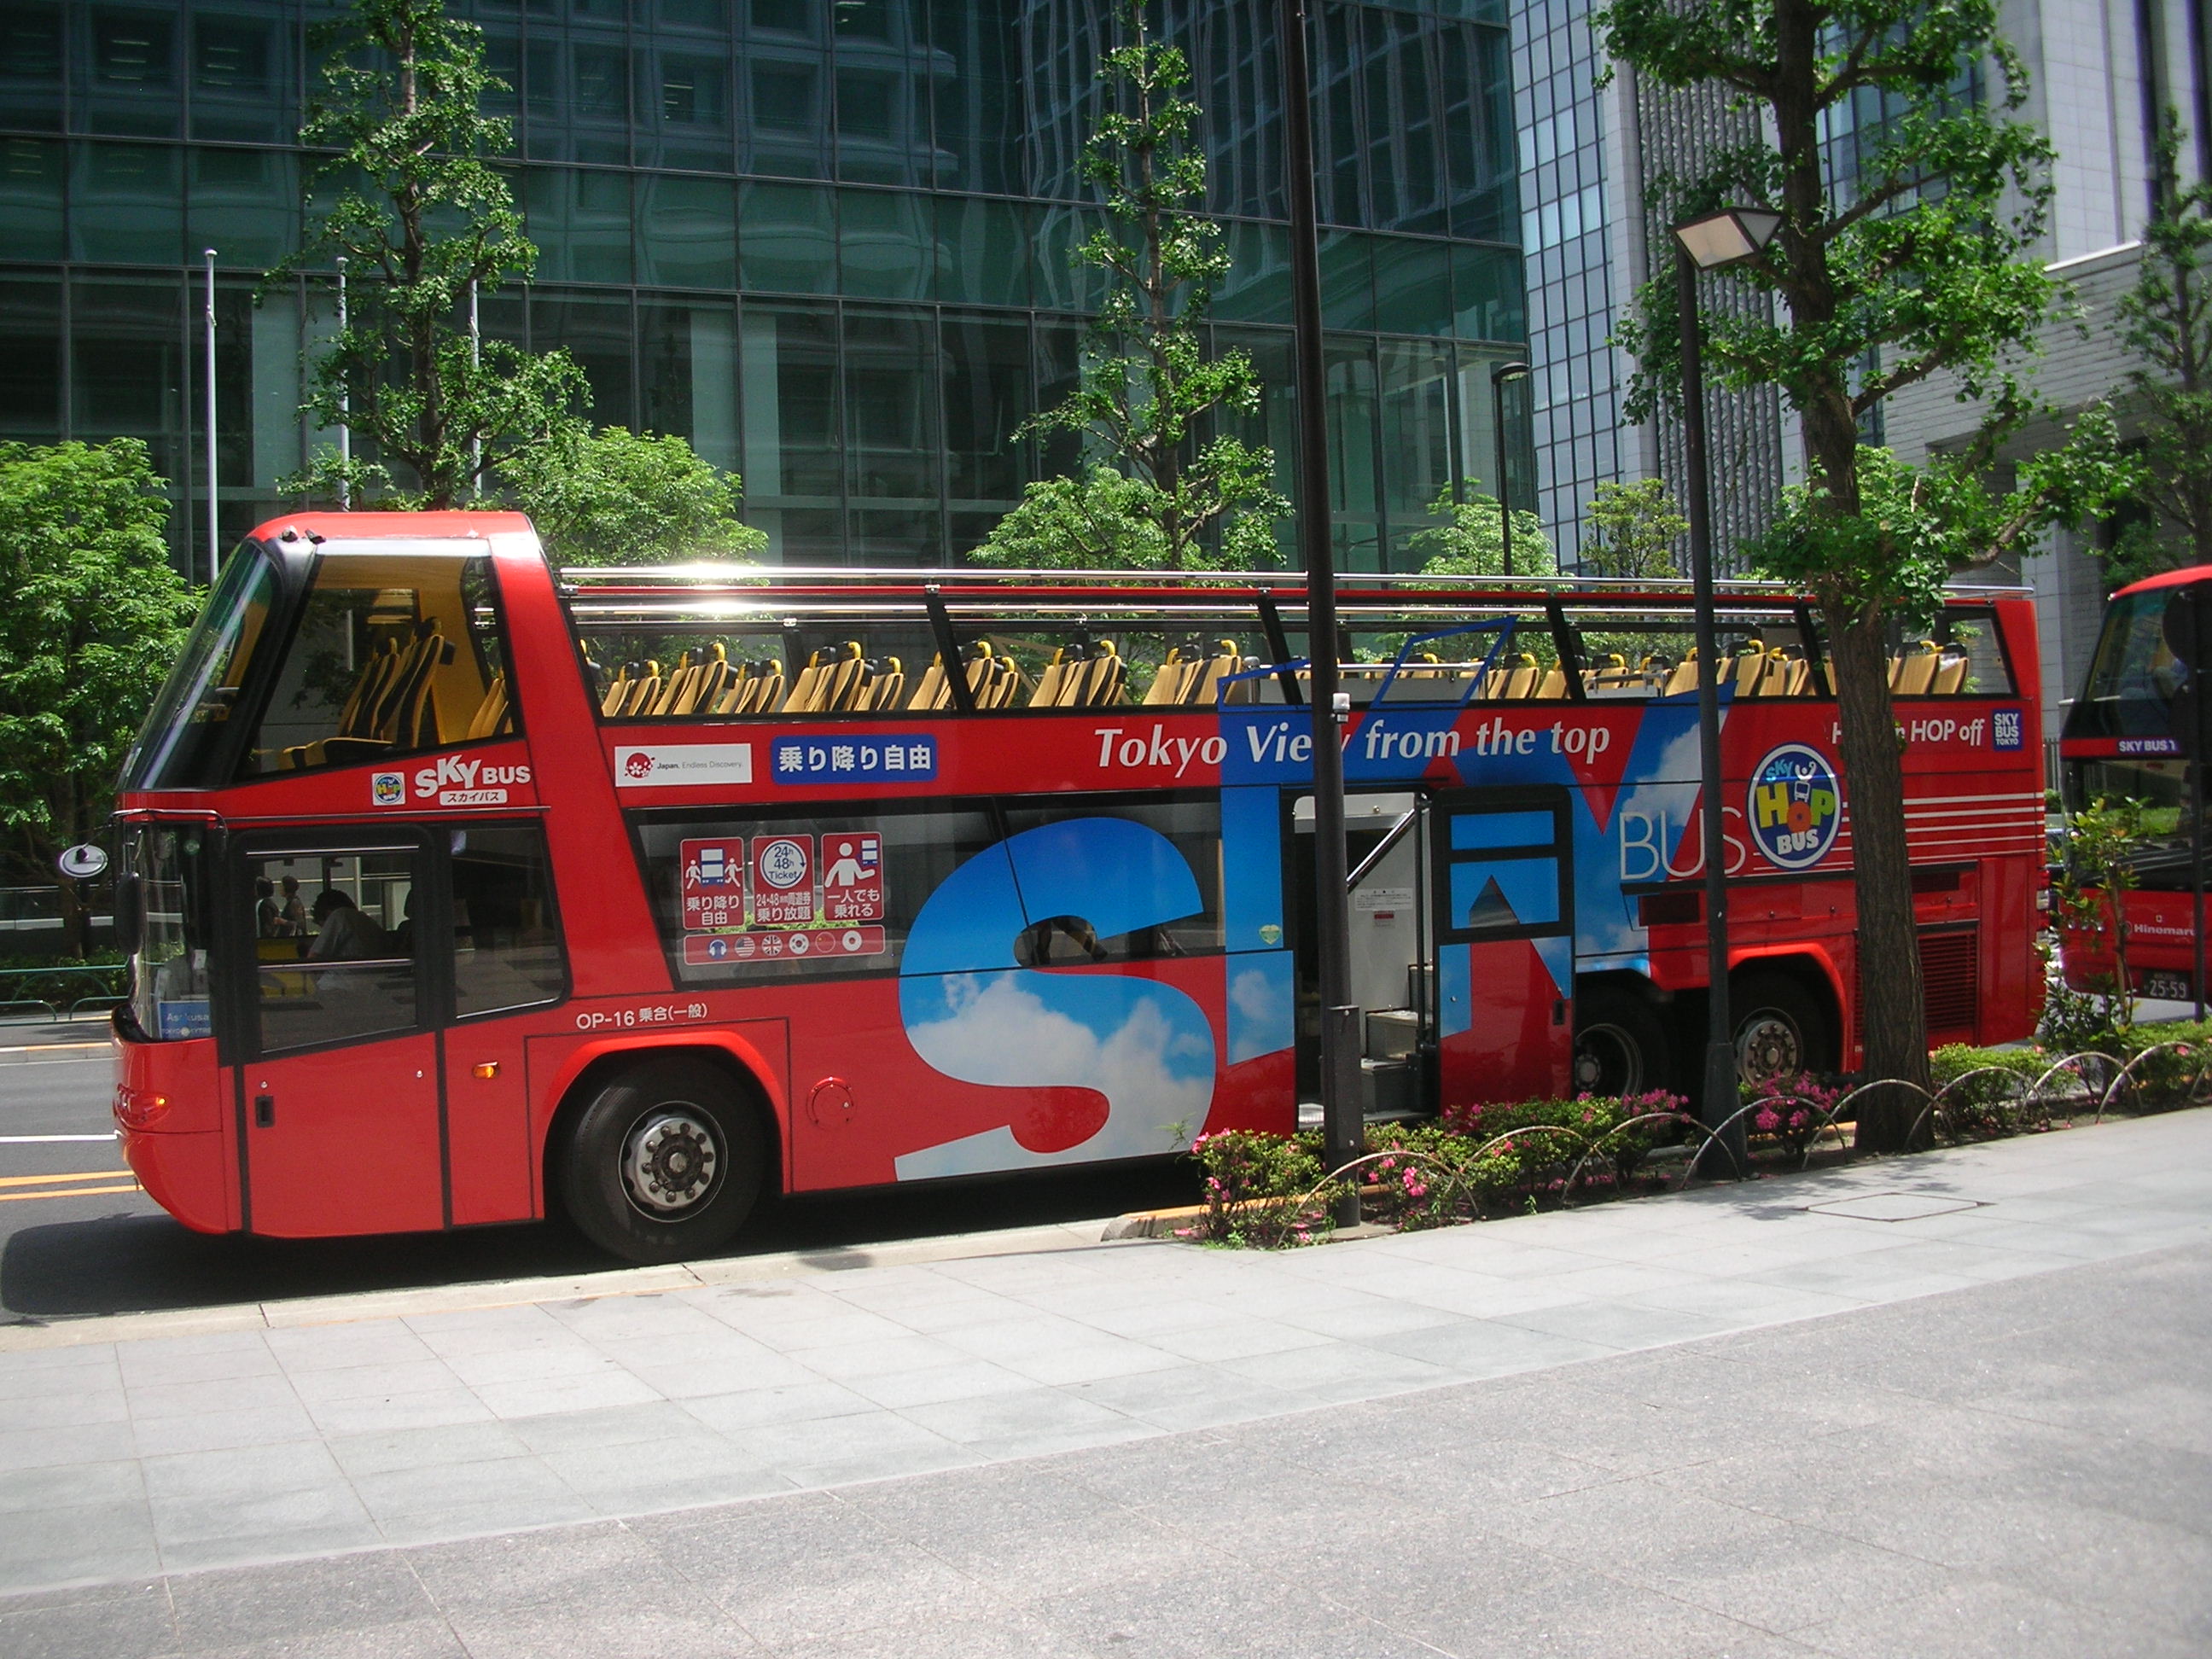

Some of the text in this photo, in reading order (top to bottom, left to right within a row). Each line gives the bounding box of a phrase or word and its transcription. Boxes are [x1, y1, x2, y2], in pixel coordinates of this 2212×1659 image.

[1994, 713, 2018, 726] SKY
[1911, 719, 1955, 742] HOP
[1959, 719, 1986, 746] off
[1995, 725, 2019, 737] BUS
[1095, 725, 1227, 778] Tokyo
[1365, 719, 1460, 760] from
[1476, 718, 1536, 756] the
[1551, 720, 1610, 764] top
[1995, 737, 2019, 746] TOKYO
[2119, 741, 2142, 752] SKY
[2144, 740, 2168, 751] BUS
[779, 744, 931, 772] 乗り降り自由
[415, 754, 531, 798] SKY BUS
[1766, 759, 1794, 781] SKY
[447, 792, 499, 802] スカイバス
[1756, 782, 1836, 833] HOP
[1620, 806, 1746, 880] BUS
[1776, 829, 1819, 855] BUS
[774, 846, 794, 859] 24h
[774, 858, 795, 870] 48h
[769, 870, 797, 880] Ticket
[686, 895, 740, 911] 乗り降り
[827, 888, 880, 903] 一人でも
[701, 911, 727, 925] 自由
[757, 906, 812, 922] 乗り放題
[835, 903, 873, 918] 乗れる
[576, 1010, 635, 1029] OP-16
